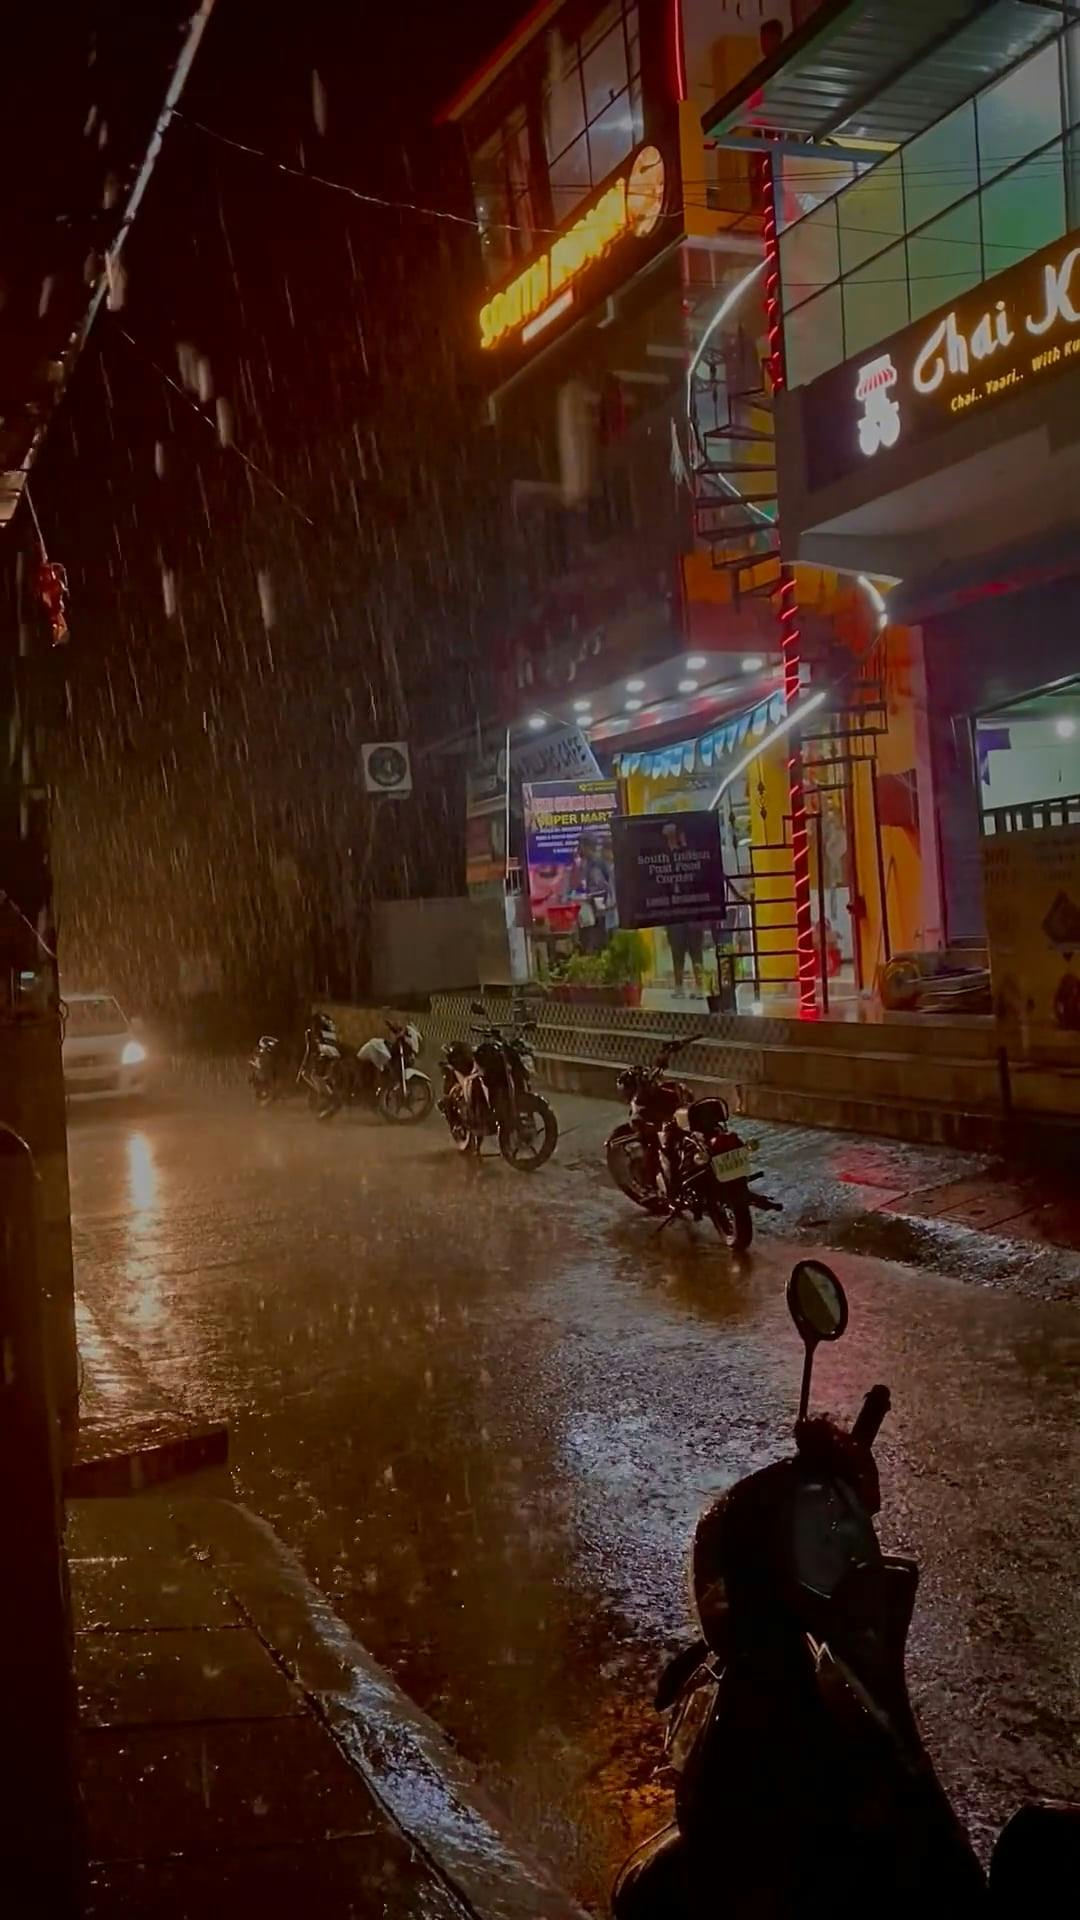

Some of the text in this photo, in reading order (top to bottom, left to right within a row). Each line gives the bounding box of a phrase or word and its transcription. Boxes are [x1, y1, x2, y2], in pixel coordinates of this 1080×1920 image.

[913, 301, 1014, 393] Chai
[1032, 346, 1060, 372] With
[537, 813, 577, 826] SUPER
[637, 850, 710, 865] South Indian
